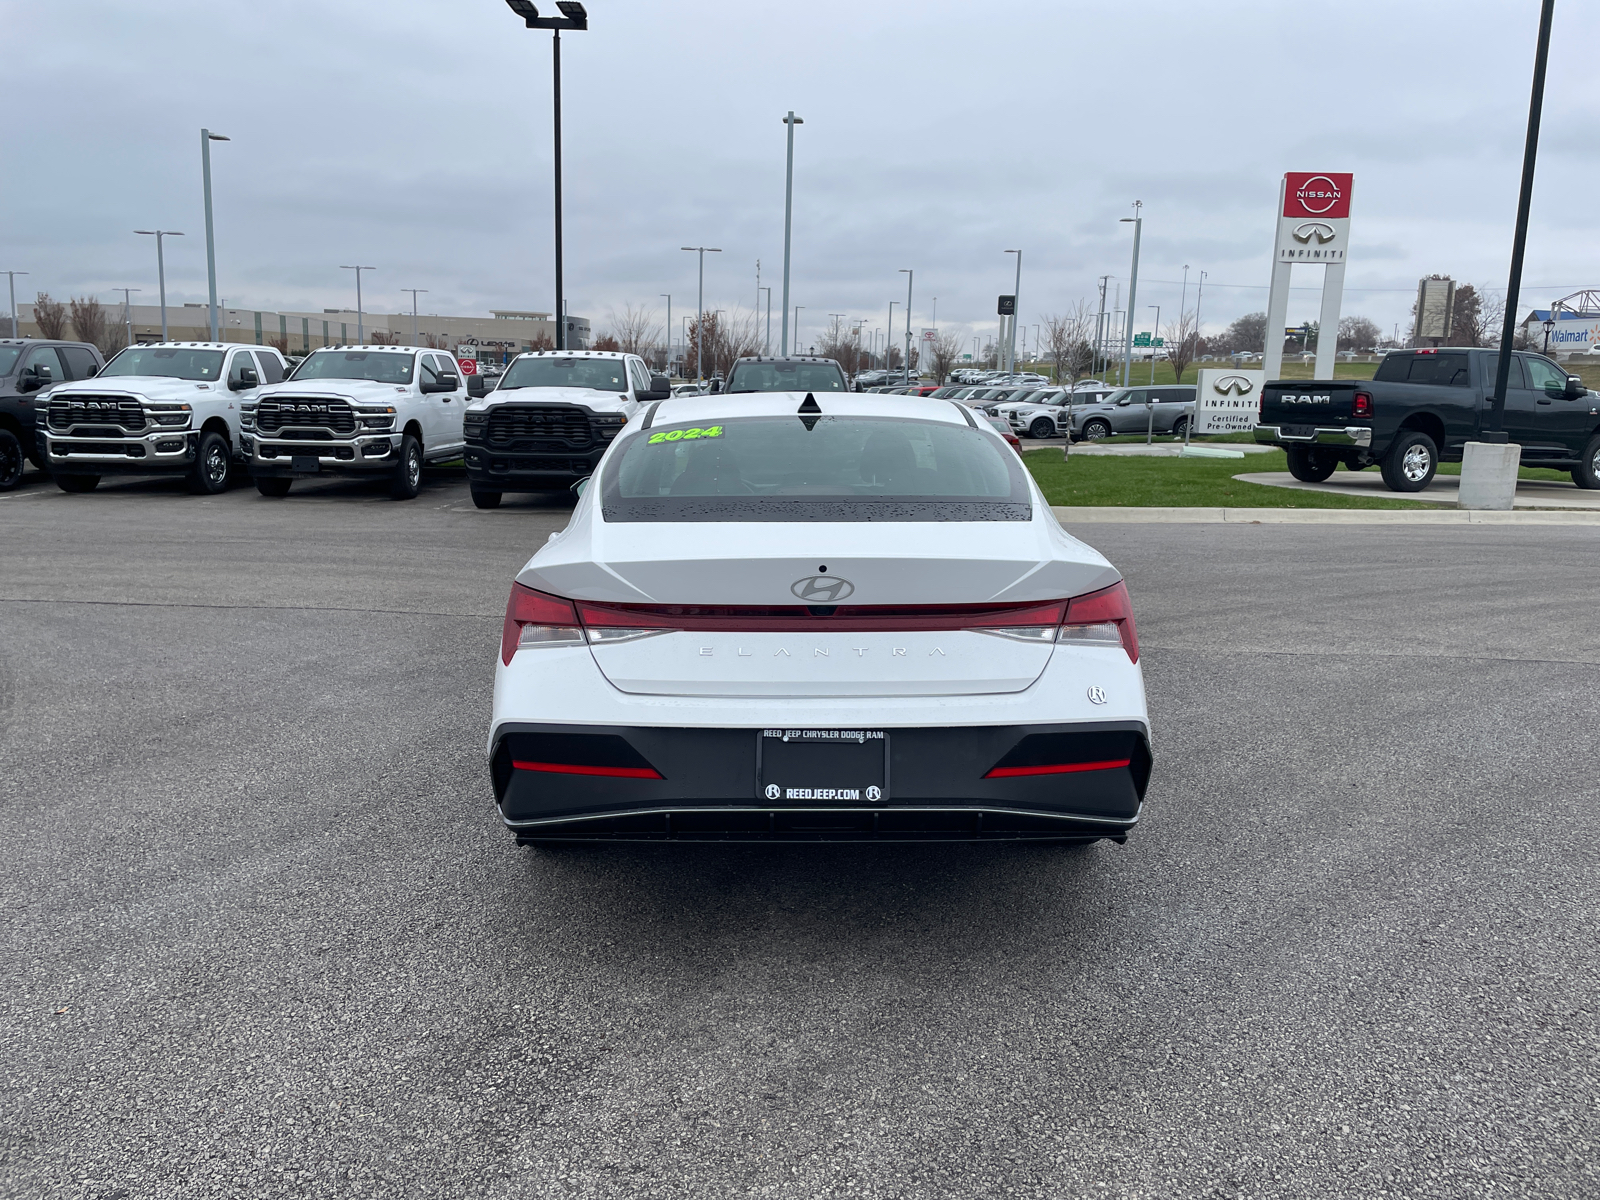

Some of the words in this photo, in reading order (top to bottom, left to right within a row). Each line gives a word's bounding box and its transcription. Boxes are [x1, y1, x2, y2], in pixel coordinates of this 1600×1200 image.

[1296, 190, 1341, 199] NISSAN
[1281, 249, 1343, 259] INFINITI
[1551, 329, 1588, 343] Walmart
[1205, 400, 1258, 408] INFINITI
[1281, 395, 1330, 404] RAM
[70, 402, 117, 410] RAM
[280, 404, 327, 412] RAM
[1212, 415, 1249, 423] Certified
[1207, 423, 1252, 431] Pre-Owned
[647, 425, 723, 444] 2024
[699, 646, 946, 657] ELANTRA
[763, 730, 782, 738] REED
[784, 730, 801, 739] JEEP
[802, 730, 839, 739] CHRYSLER
[840, 731, 865, 739] DODGE
[866, 731, 884, 739] RAM
[786, 788, 860, 800] REEDJEEP.COM
